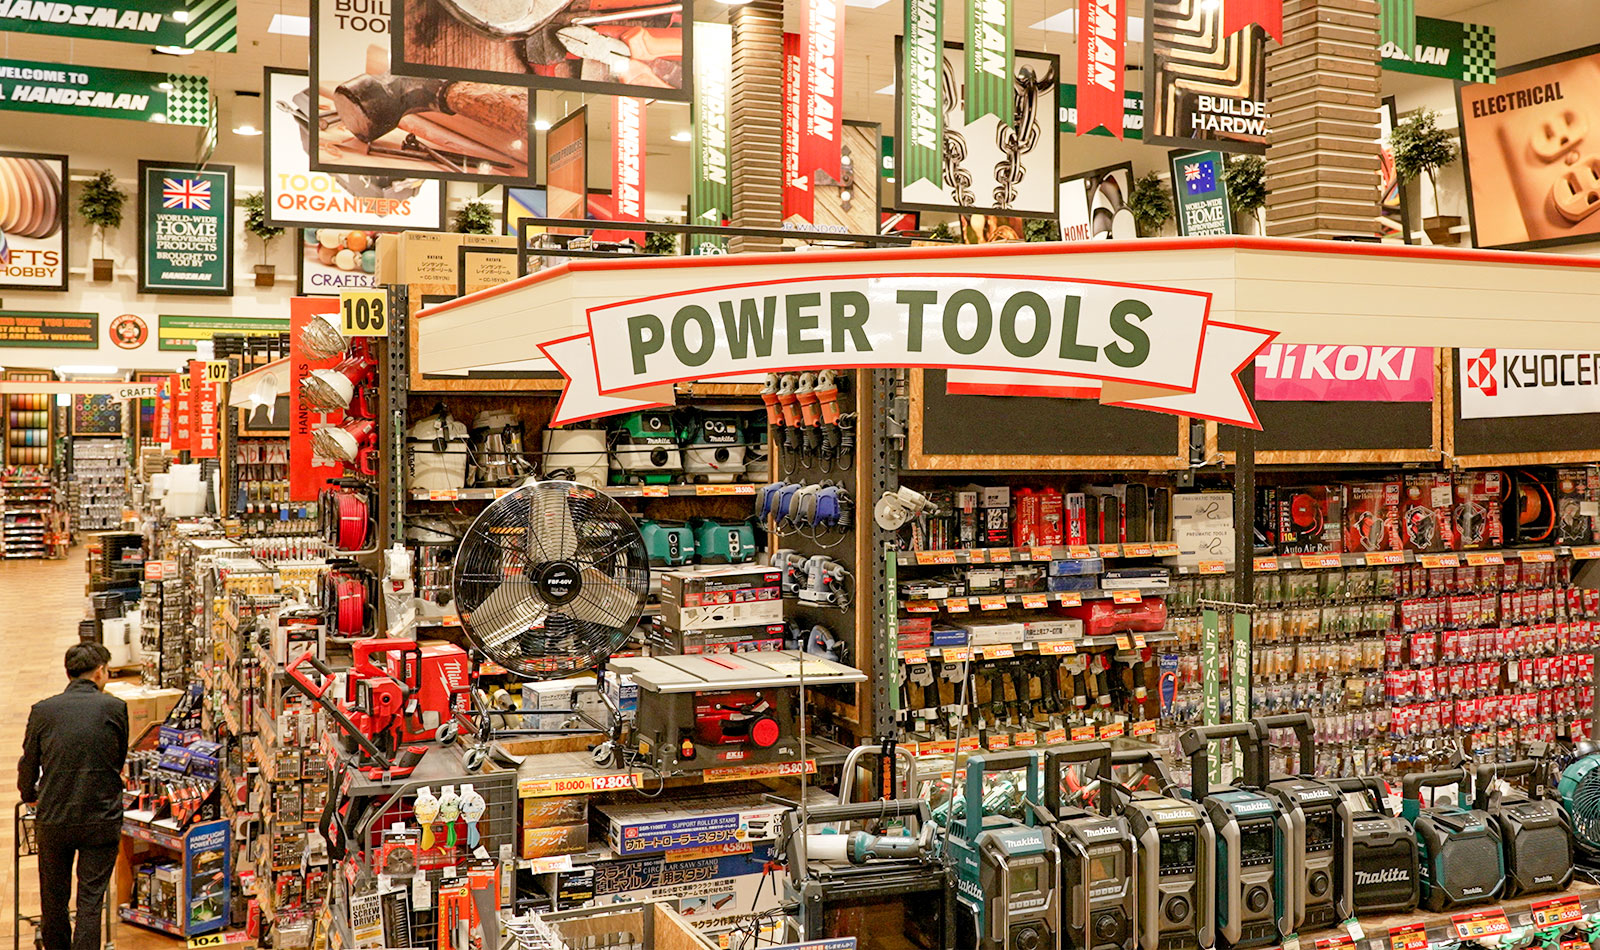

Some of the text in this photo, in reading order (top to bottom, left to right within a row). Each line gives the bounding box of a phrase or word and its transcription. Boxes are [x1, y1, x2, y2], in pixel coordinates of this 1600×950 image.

[814, 0, 836, 141] ANDSMAN
[68, 73, 89, 85] TO
[11, 84, 149, 111] HANDSMAN
[1472, 81, 1563, 118] ELECTRICAL
[1198, 95, 1266, 118] BUILDE
[1191, 112, 1270, 136] HARDW
[278, 173, 341, 193] TOOL
[277, 193, 411, 217] ORGANIZERS
[157, 214, 217, 223] WORLD-WIDE
[1186, 206, 1224, 225] HOME
[156, 221, 217, 236] HOME
[1064, 223, 1090, 241] HOME
[156, 241, 217, 251] PRODUCTS
[157, 234, 217, 243] IMPROVEMENT
[157, 252, 202, 260] BROUGHT
[170, 259, 190, 267] YOU
[311, 273, 367, 286] CRAFTS
[343, 298, 384, 329] 103
[627, 289, 1153, 375] POWER TOOLS
[208, 365, 227, 380] 107
[120, 387, 157, 398] CRAFTS
[299, 404, 308, 434] HAND
[1284, 545, 1303, 555] Auto
[1304, 543, 1316, 553] Air
[672, 821, 696, 829] SUPPORT
[697, 819, 718, 827] ROLLER
[190, 836, 225, 849] POWER LIGHT
[625, 829, 736, 851] サポートローラースタンド
[596, 862, 642, 880] スライド
[643, 858, 719, 875] CIRCLAR SAW STAND
[352, 901, 380, 911] ELECTRIC
[352, 907, 380, 919] SCREW
[354, 914, 380, 926] DRIVER
[191, 937, 221, 947] 104
